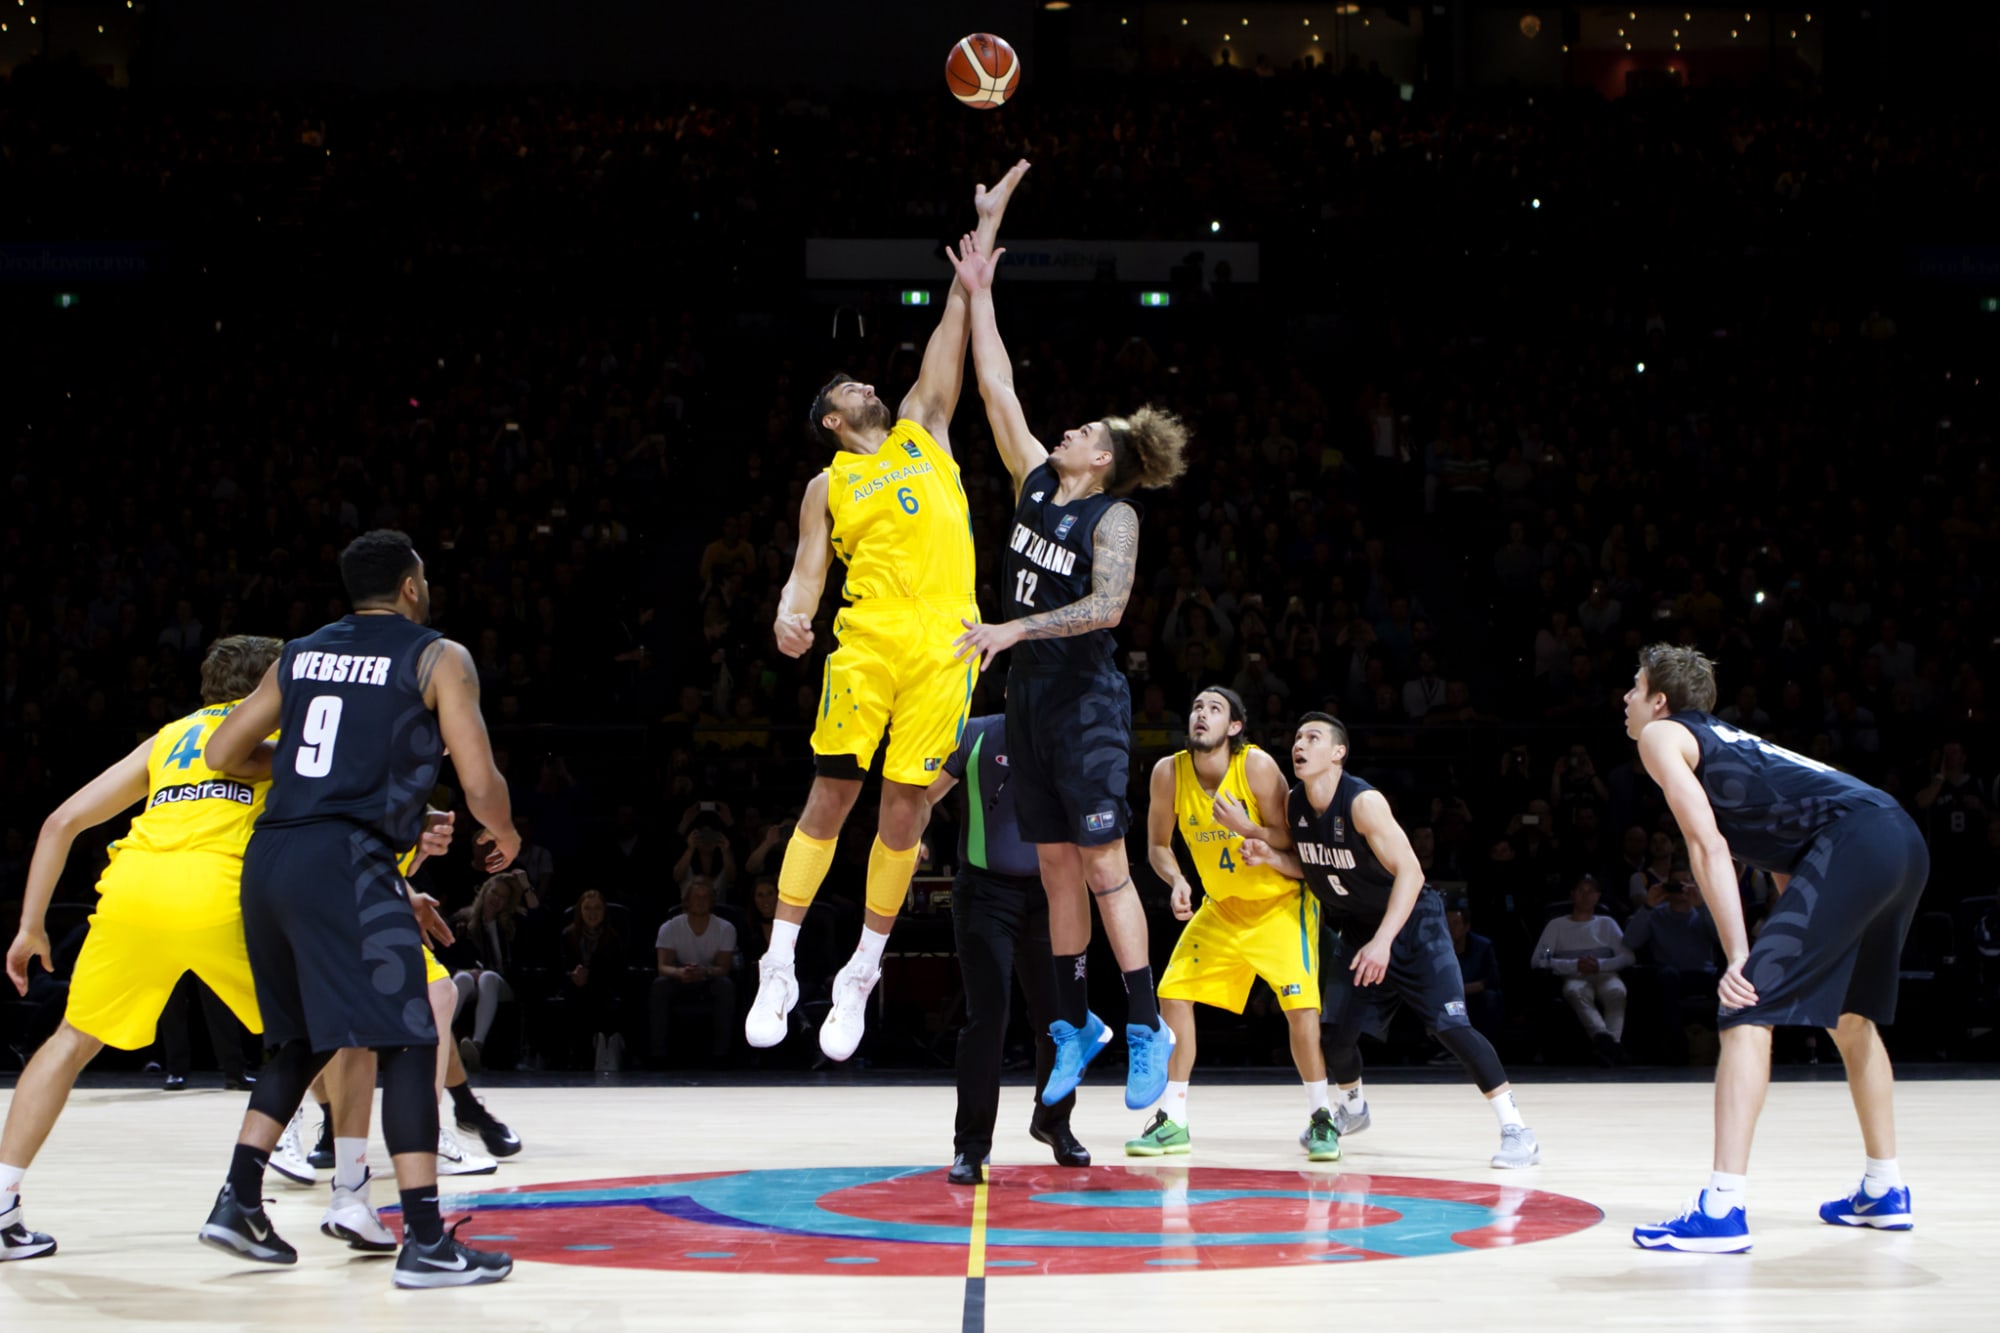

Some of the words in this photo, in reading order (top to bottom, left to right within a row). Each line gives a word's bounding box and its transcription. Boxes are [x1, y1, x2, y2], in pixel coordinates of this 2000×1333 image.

[1003, 252, 1051, 265] AVER
[853, 461, 935, 503] AUSTRALIA
[897, 487, 919, 515] 6
[1015, 568, 1039, 608] 12
[292, 650, 392, 686] WEBSTER
[162, 723, 205, 770] 4
[295, 695, 343, 778] 9
[153, 782, 253, 806] australia
[1195, 829, 1238, 843] USTRA
[1219, 847, 1235, 873] 4
